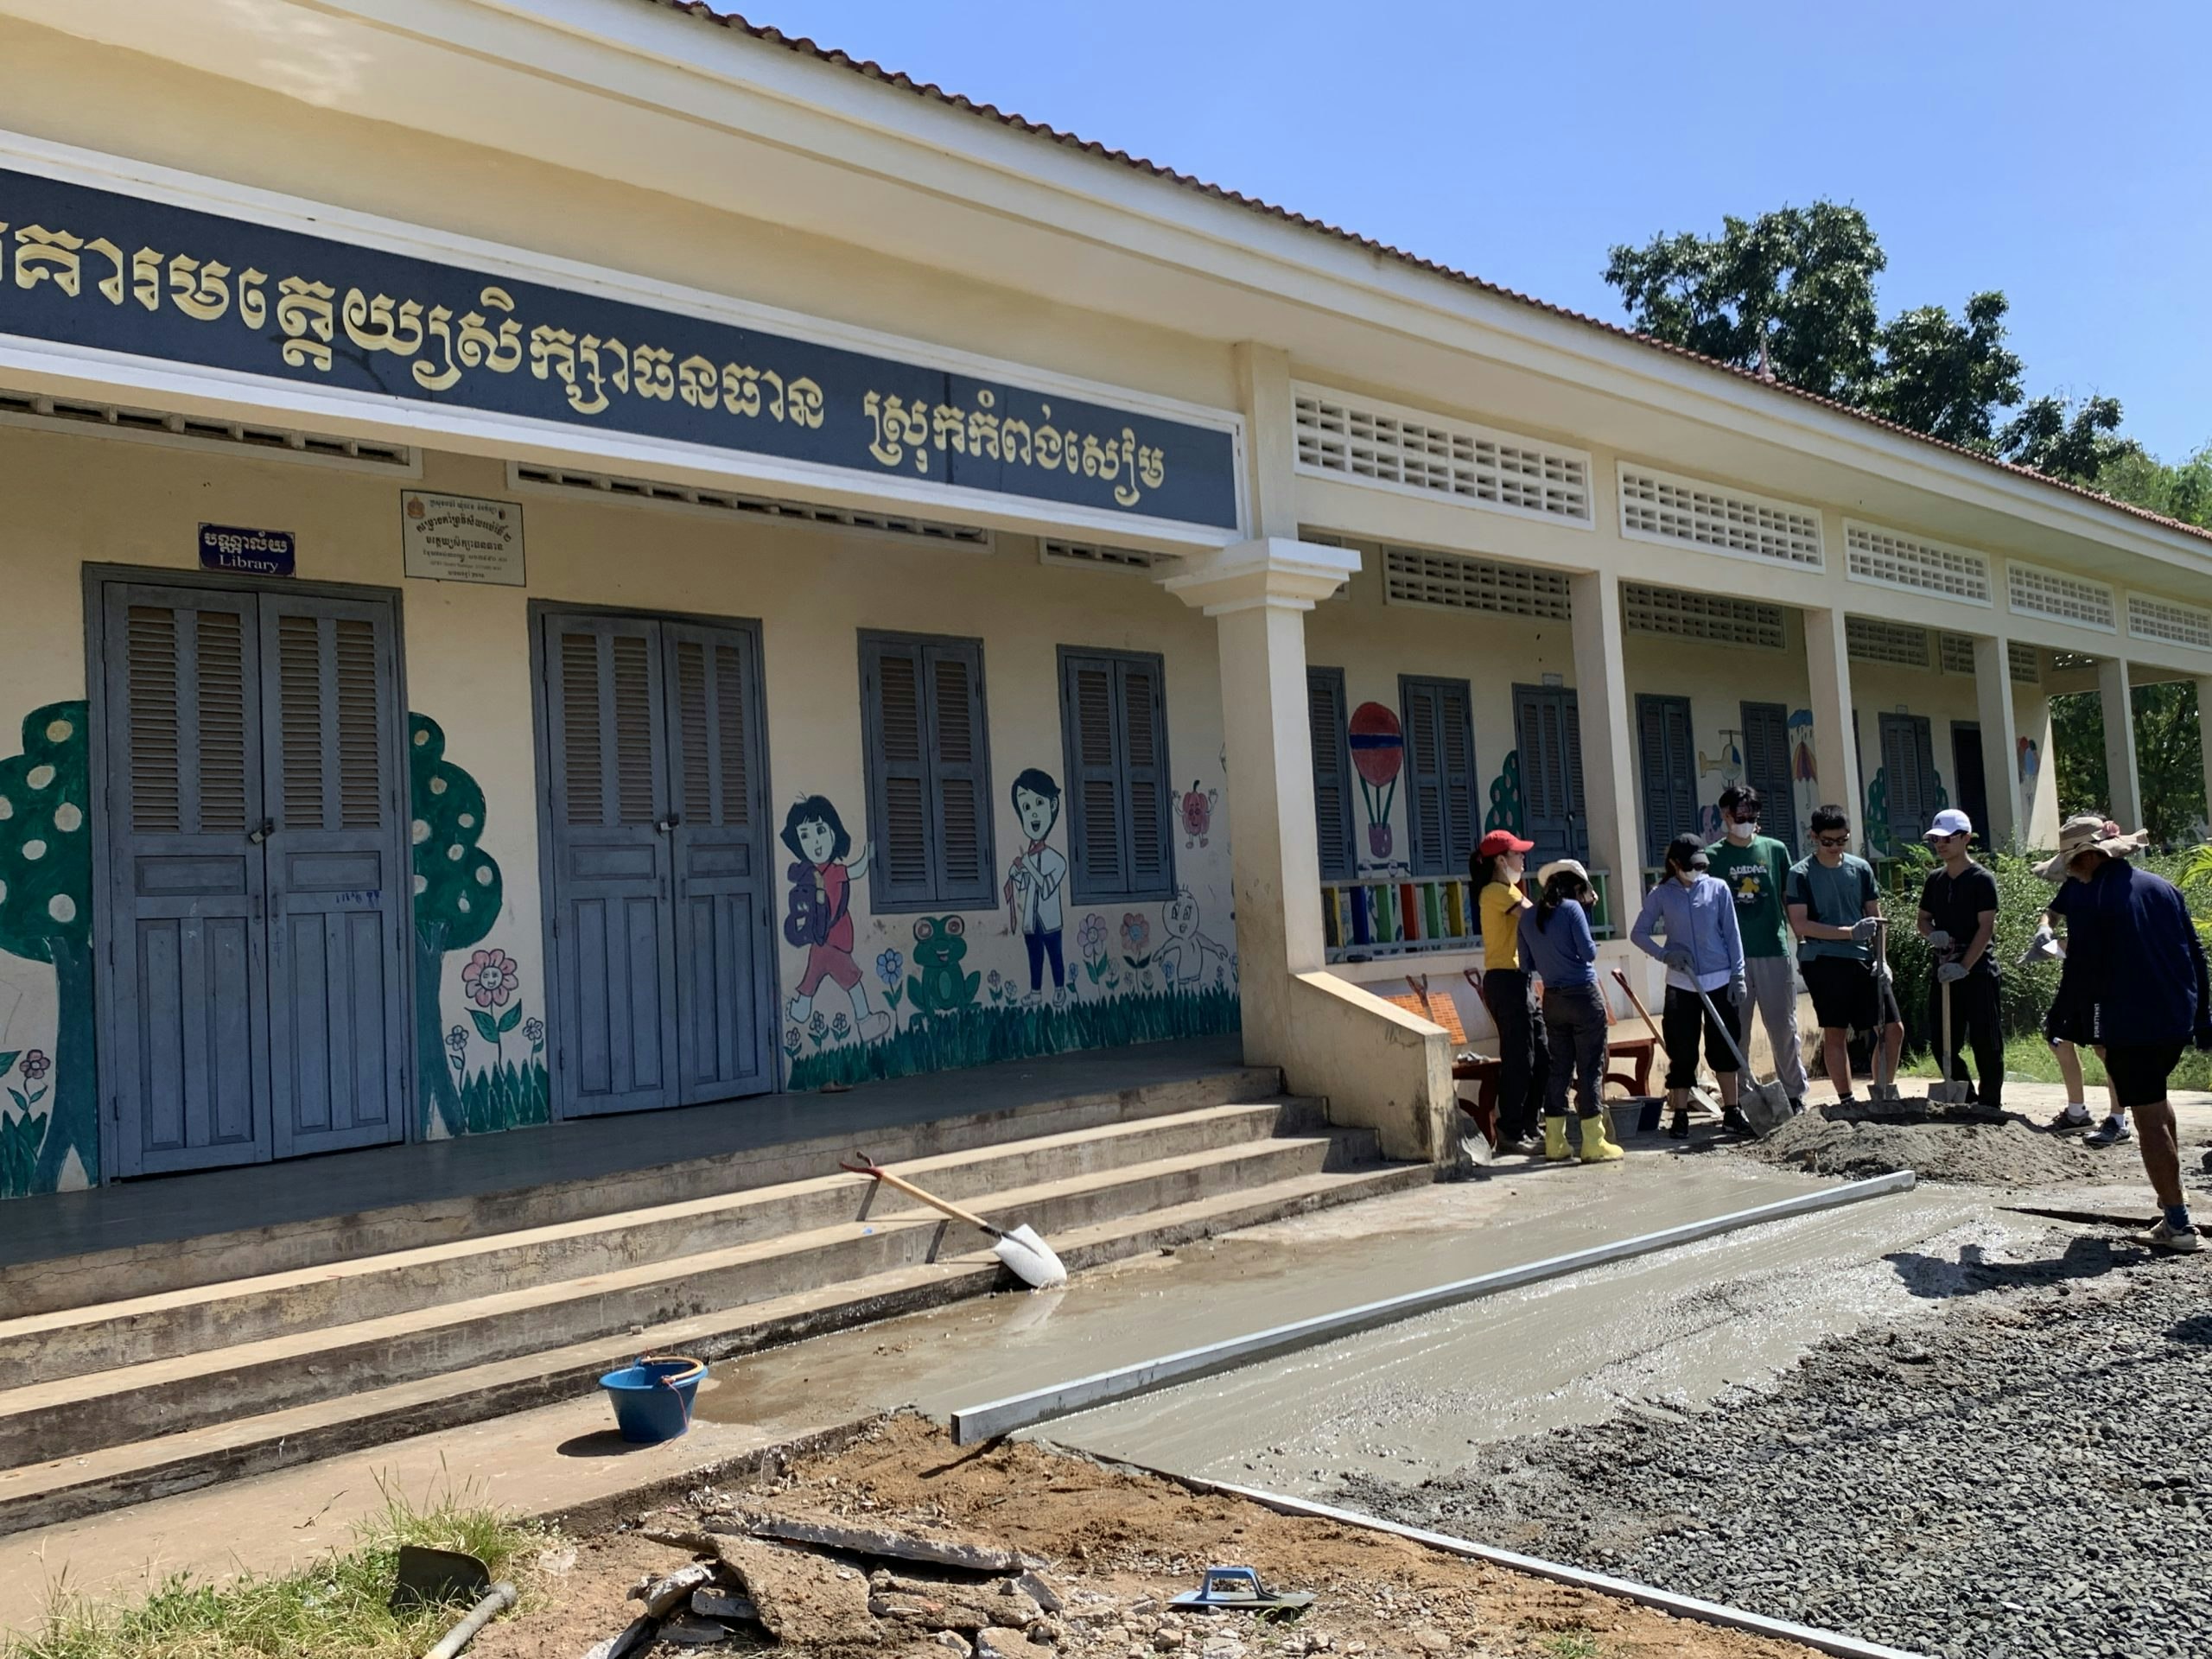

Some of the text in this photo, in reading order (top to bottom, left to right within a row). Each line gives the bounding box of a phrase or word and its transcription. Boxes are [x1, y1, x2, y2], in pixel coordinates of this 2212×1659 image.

[0, 219, 824, 429] គារមត្តេយ្យសិក្សាធនធាន
[219, 554, 278, 574] Library
